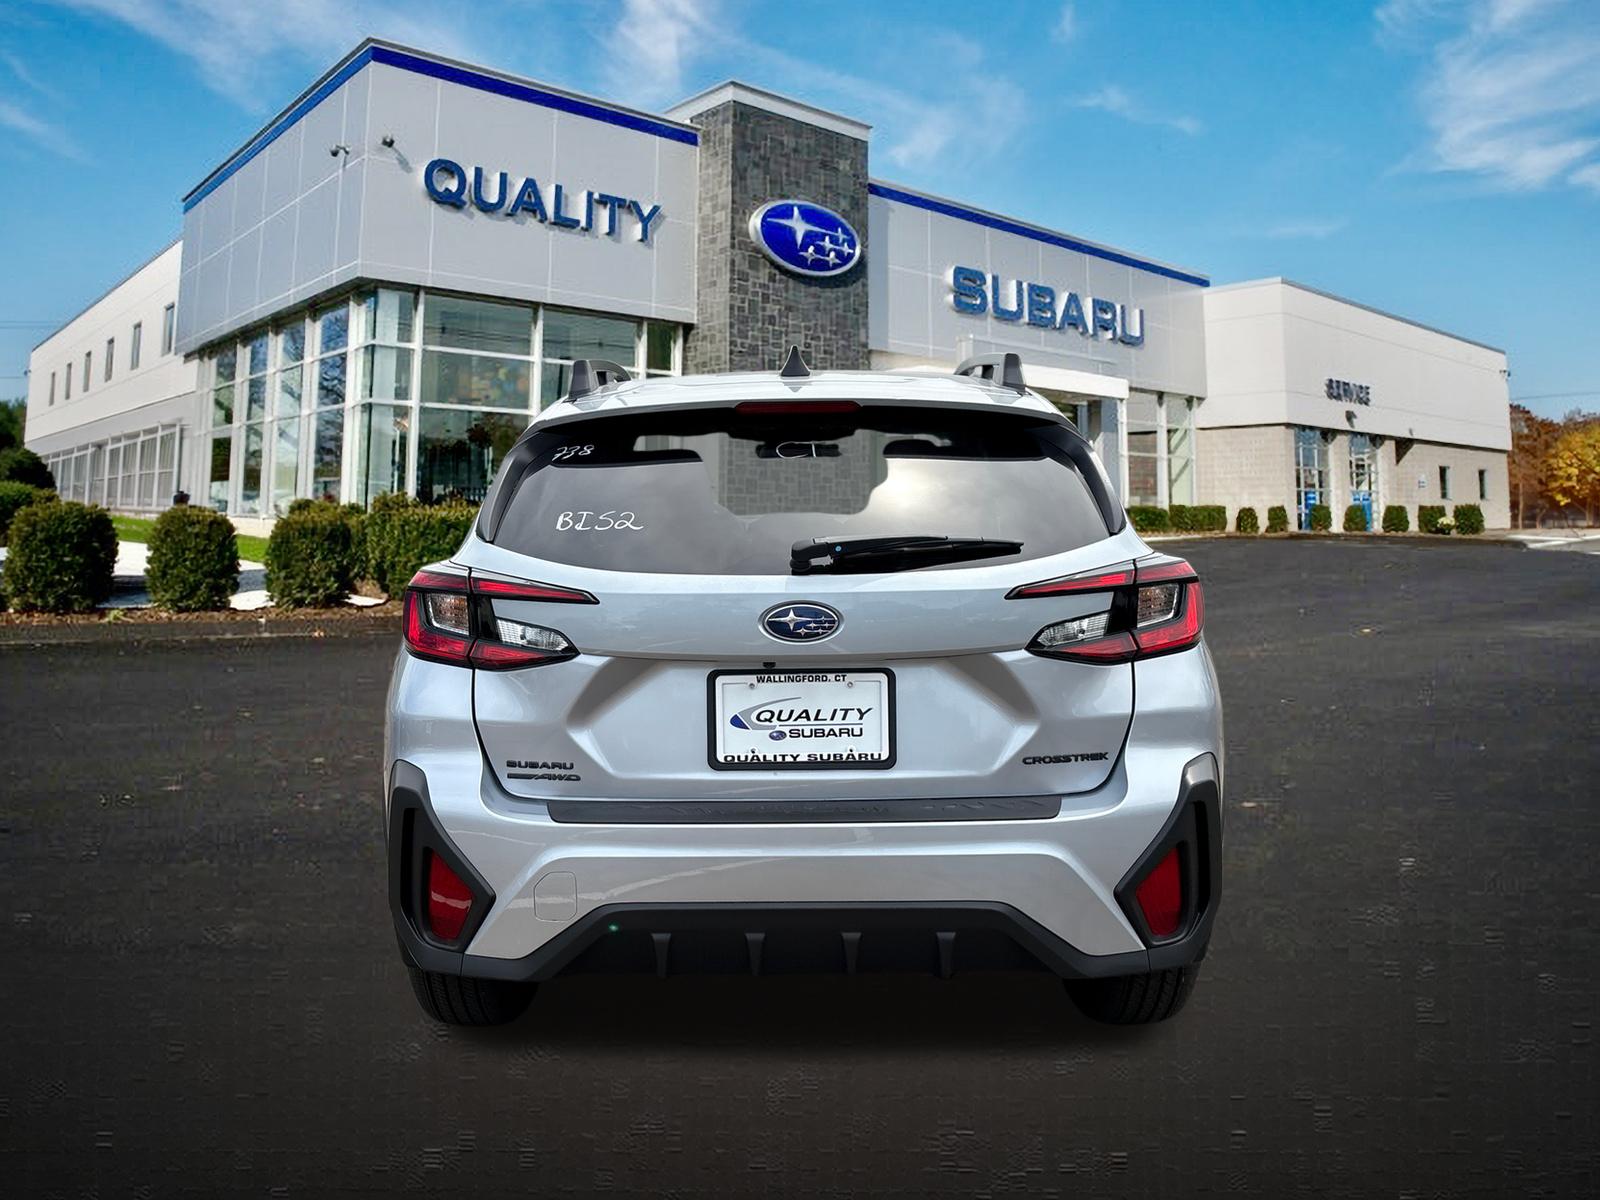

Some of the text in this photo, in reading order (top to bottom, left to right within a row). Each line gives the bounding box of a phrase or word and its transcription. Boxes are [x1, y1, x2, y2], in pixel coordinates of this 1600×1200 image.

[424, 158, 662, 242] QUALITY
[951, 265, 1145, 346] SUBARU
[1325, 378, 1371, 406] SERVICE
[834, 674, 847, 682] CT
[755, 707, 873, 723] QUALITY
[788, 727, 863, 739] SUBARU
[723, 752, 882, 763] QUALITY SUBARU
[1022, 752, 1109, 765] CROSSTREK
[506, 760, 574, 770] SUBARU
[534, 773, 581, 782] AWD
